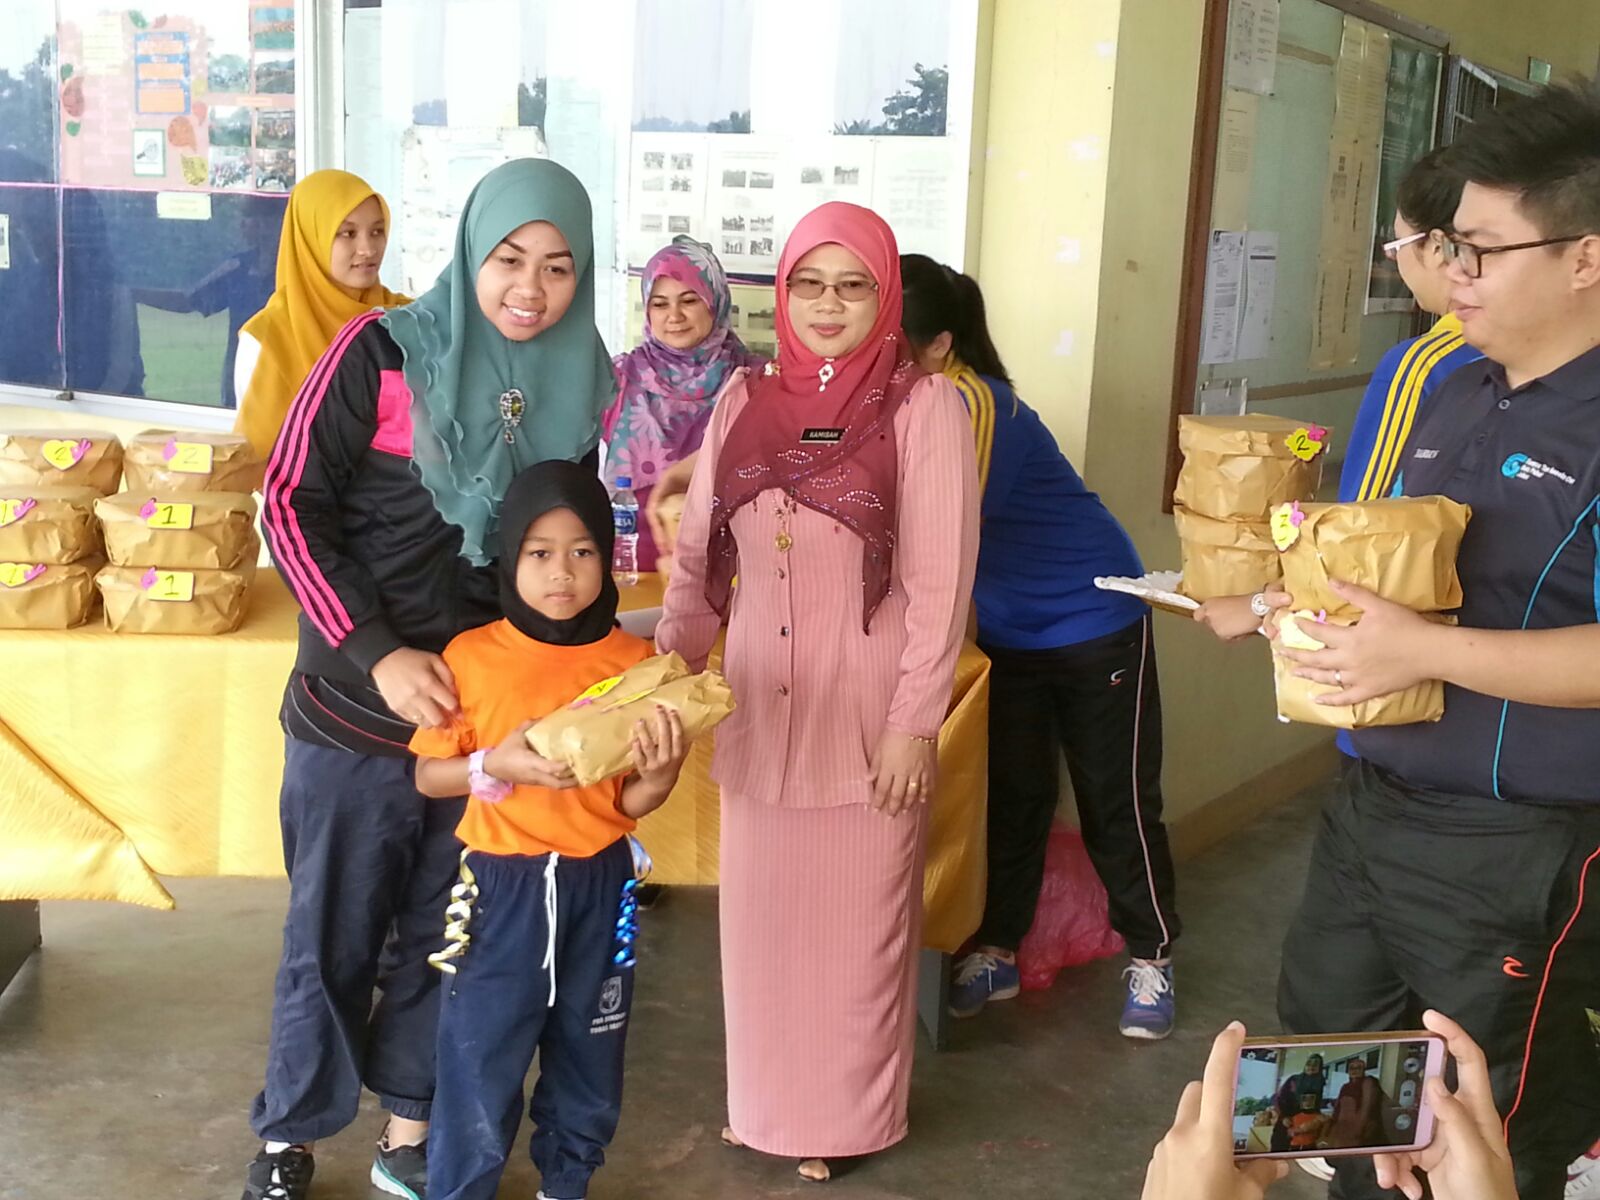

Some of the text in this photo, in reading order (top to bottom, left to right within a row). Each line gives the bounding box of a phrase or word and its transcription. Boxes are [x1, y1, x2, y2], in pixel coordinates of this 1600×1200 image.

[1296, 434, 1310, 451] 2
[54, 446, 67, 461] 2
[183, 446, 199, 464] 2
[161, 505, 177, 525] 1
[164, 574, 179, 595] 1
